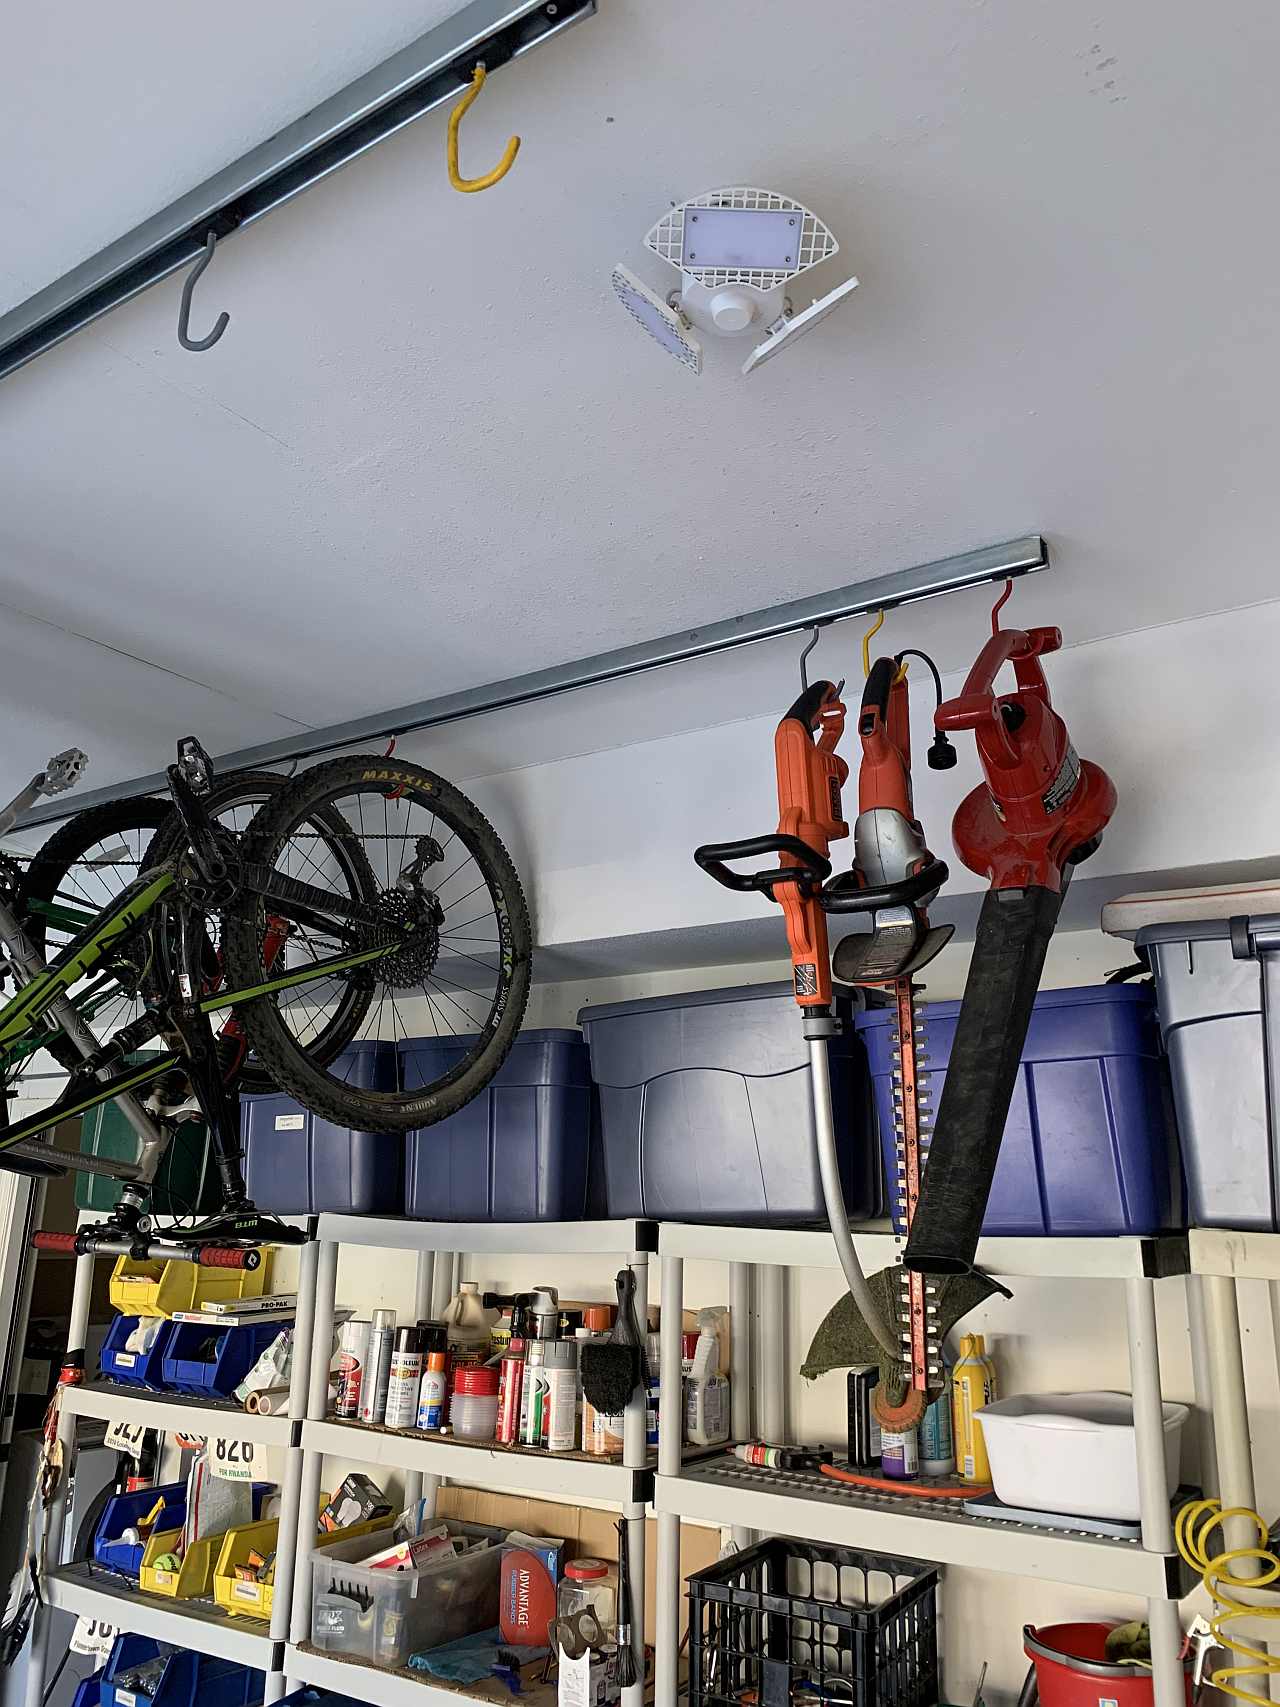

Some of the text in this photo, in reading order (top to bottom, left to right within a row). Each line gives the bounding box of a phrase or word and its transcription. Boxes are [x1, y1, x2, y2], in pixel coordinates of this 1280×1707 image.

[361, 769, 433, 791] MAXXIS
[261, 1300, 288, 1309] PRO-PAK
[518, 1568, 531, 1627] ADVANTAGE
